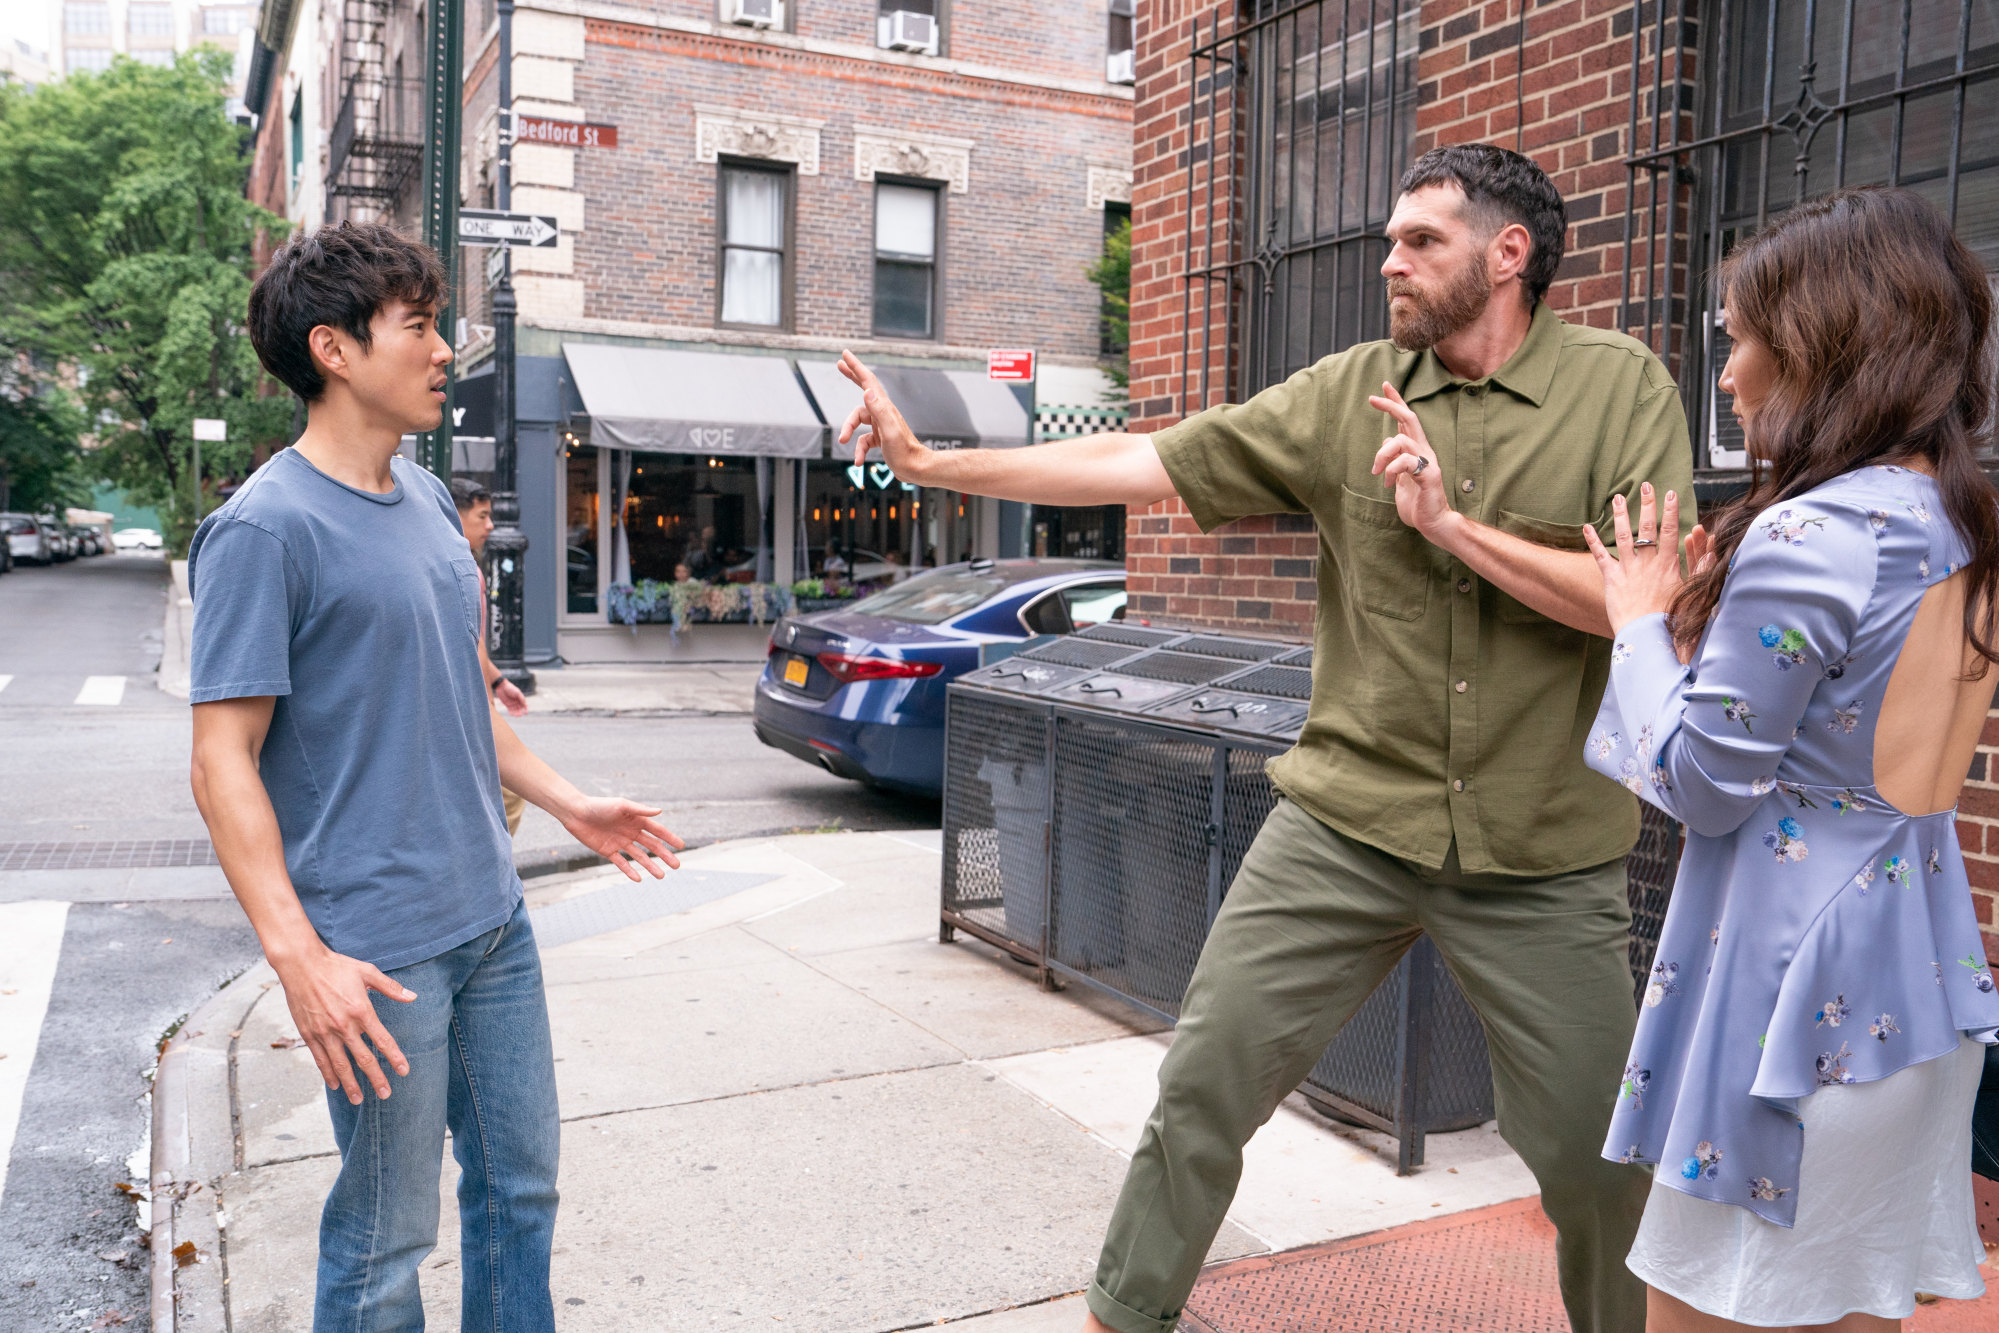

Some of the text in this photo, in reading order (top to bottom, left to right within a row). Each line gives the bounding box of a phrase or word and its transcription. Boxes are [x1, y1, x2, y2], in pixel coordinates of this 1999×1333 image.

[519, 119, 599, 145] Bedford St
[464, 221, 544, 238] ONE WAY
